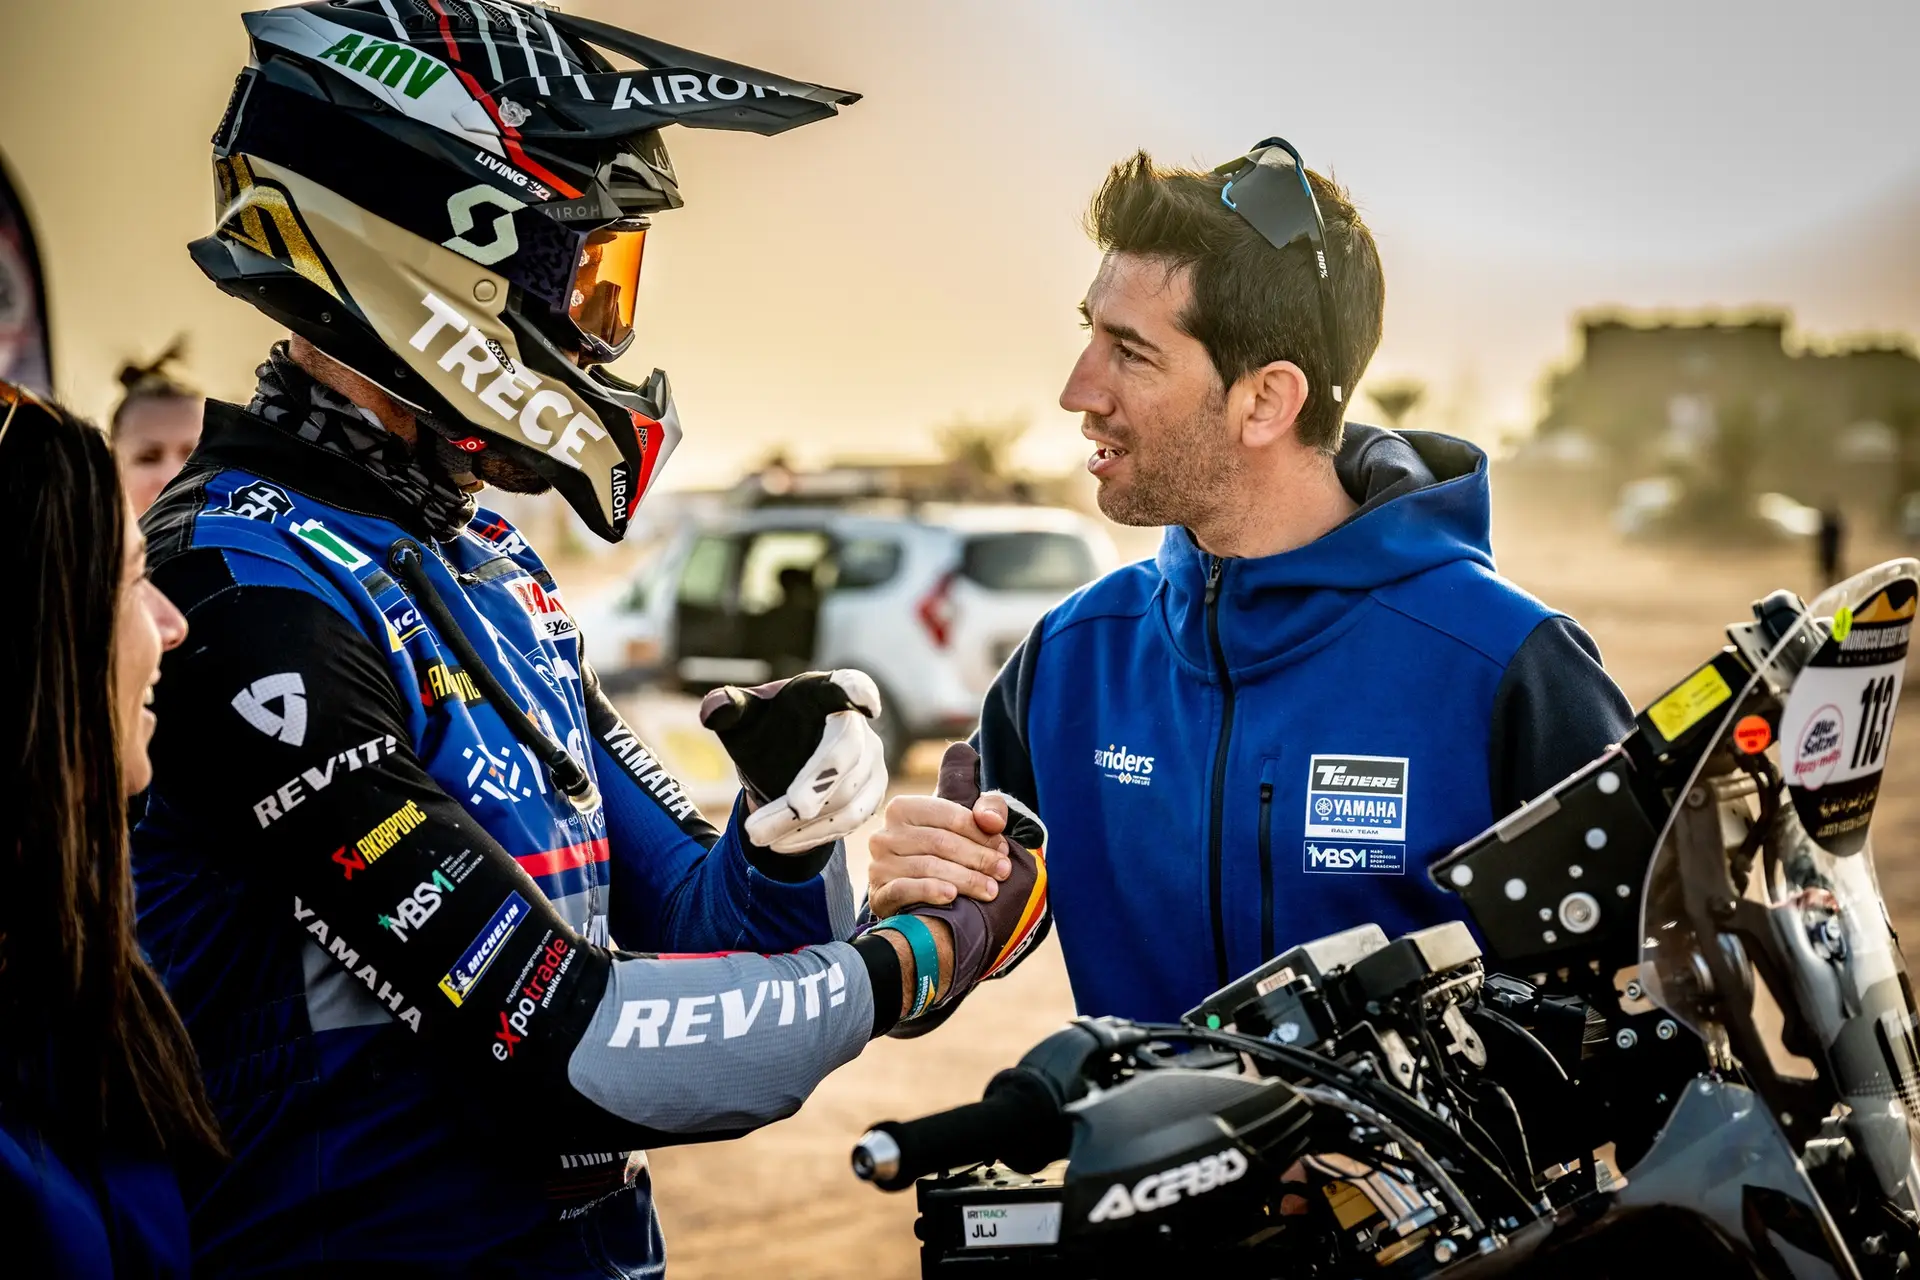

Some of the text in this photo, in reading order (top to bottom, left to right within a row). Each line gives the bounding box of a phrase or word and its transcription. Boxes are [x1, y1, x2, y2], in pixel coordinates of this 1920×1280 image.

[475, 151, 528, 187] LIVING
[1315, 249, 1329, 279] 100%
[408, 293, 608, 470] TRECE
[613, 468, 627, 521] AIROH
[1849, 674, 1895, 770] 113
[602, 720, 696, 821] YAMAHA
[1102, 744, 1155, 774] riders
[1320, 816, 1392, 824] RACING
[1333, 799, 1397, 818] YAMAHA
[1310, 848, 1366, 868] MBSM
[387, 869, 455, 943] MBSM
[293, 896, 424, 1034] YAMAHA
[468, 904, 520, 974] MICHELIN
[505, 929, 554, 1004] expotradegroup.com
[541, 947, 577, 1009] mobile ideas
[967, 1208, 1008, 1219] IRITRACK
[972, 1223, 997, 1238] JLJ
